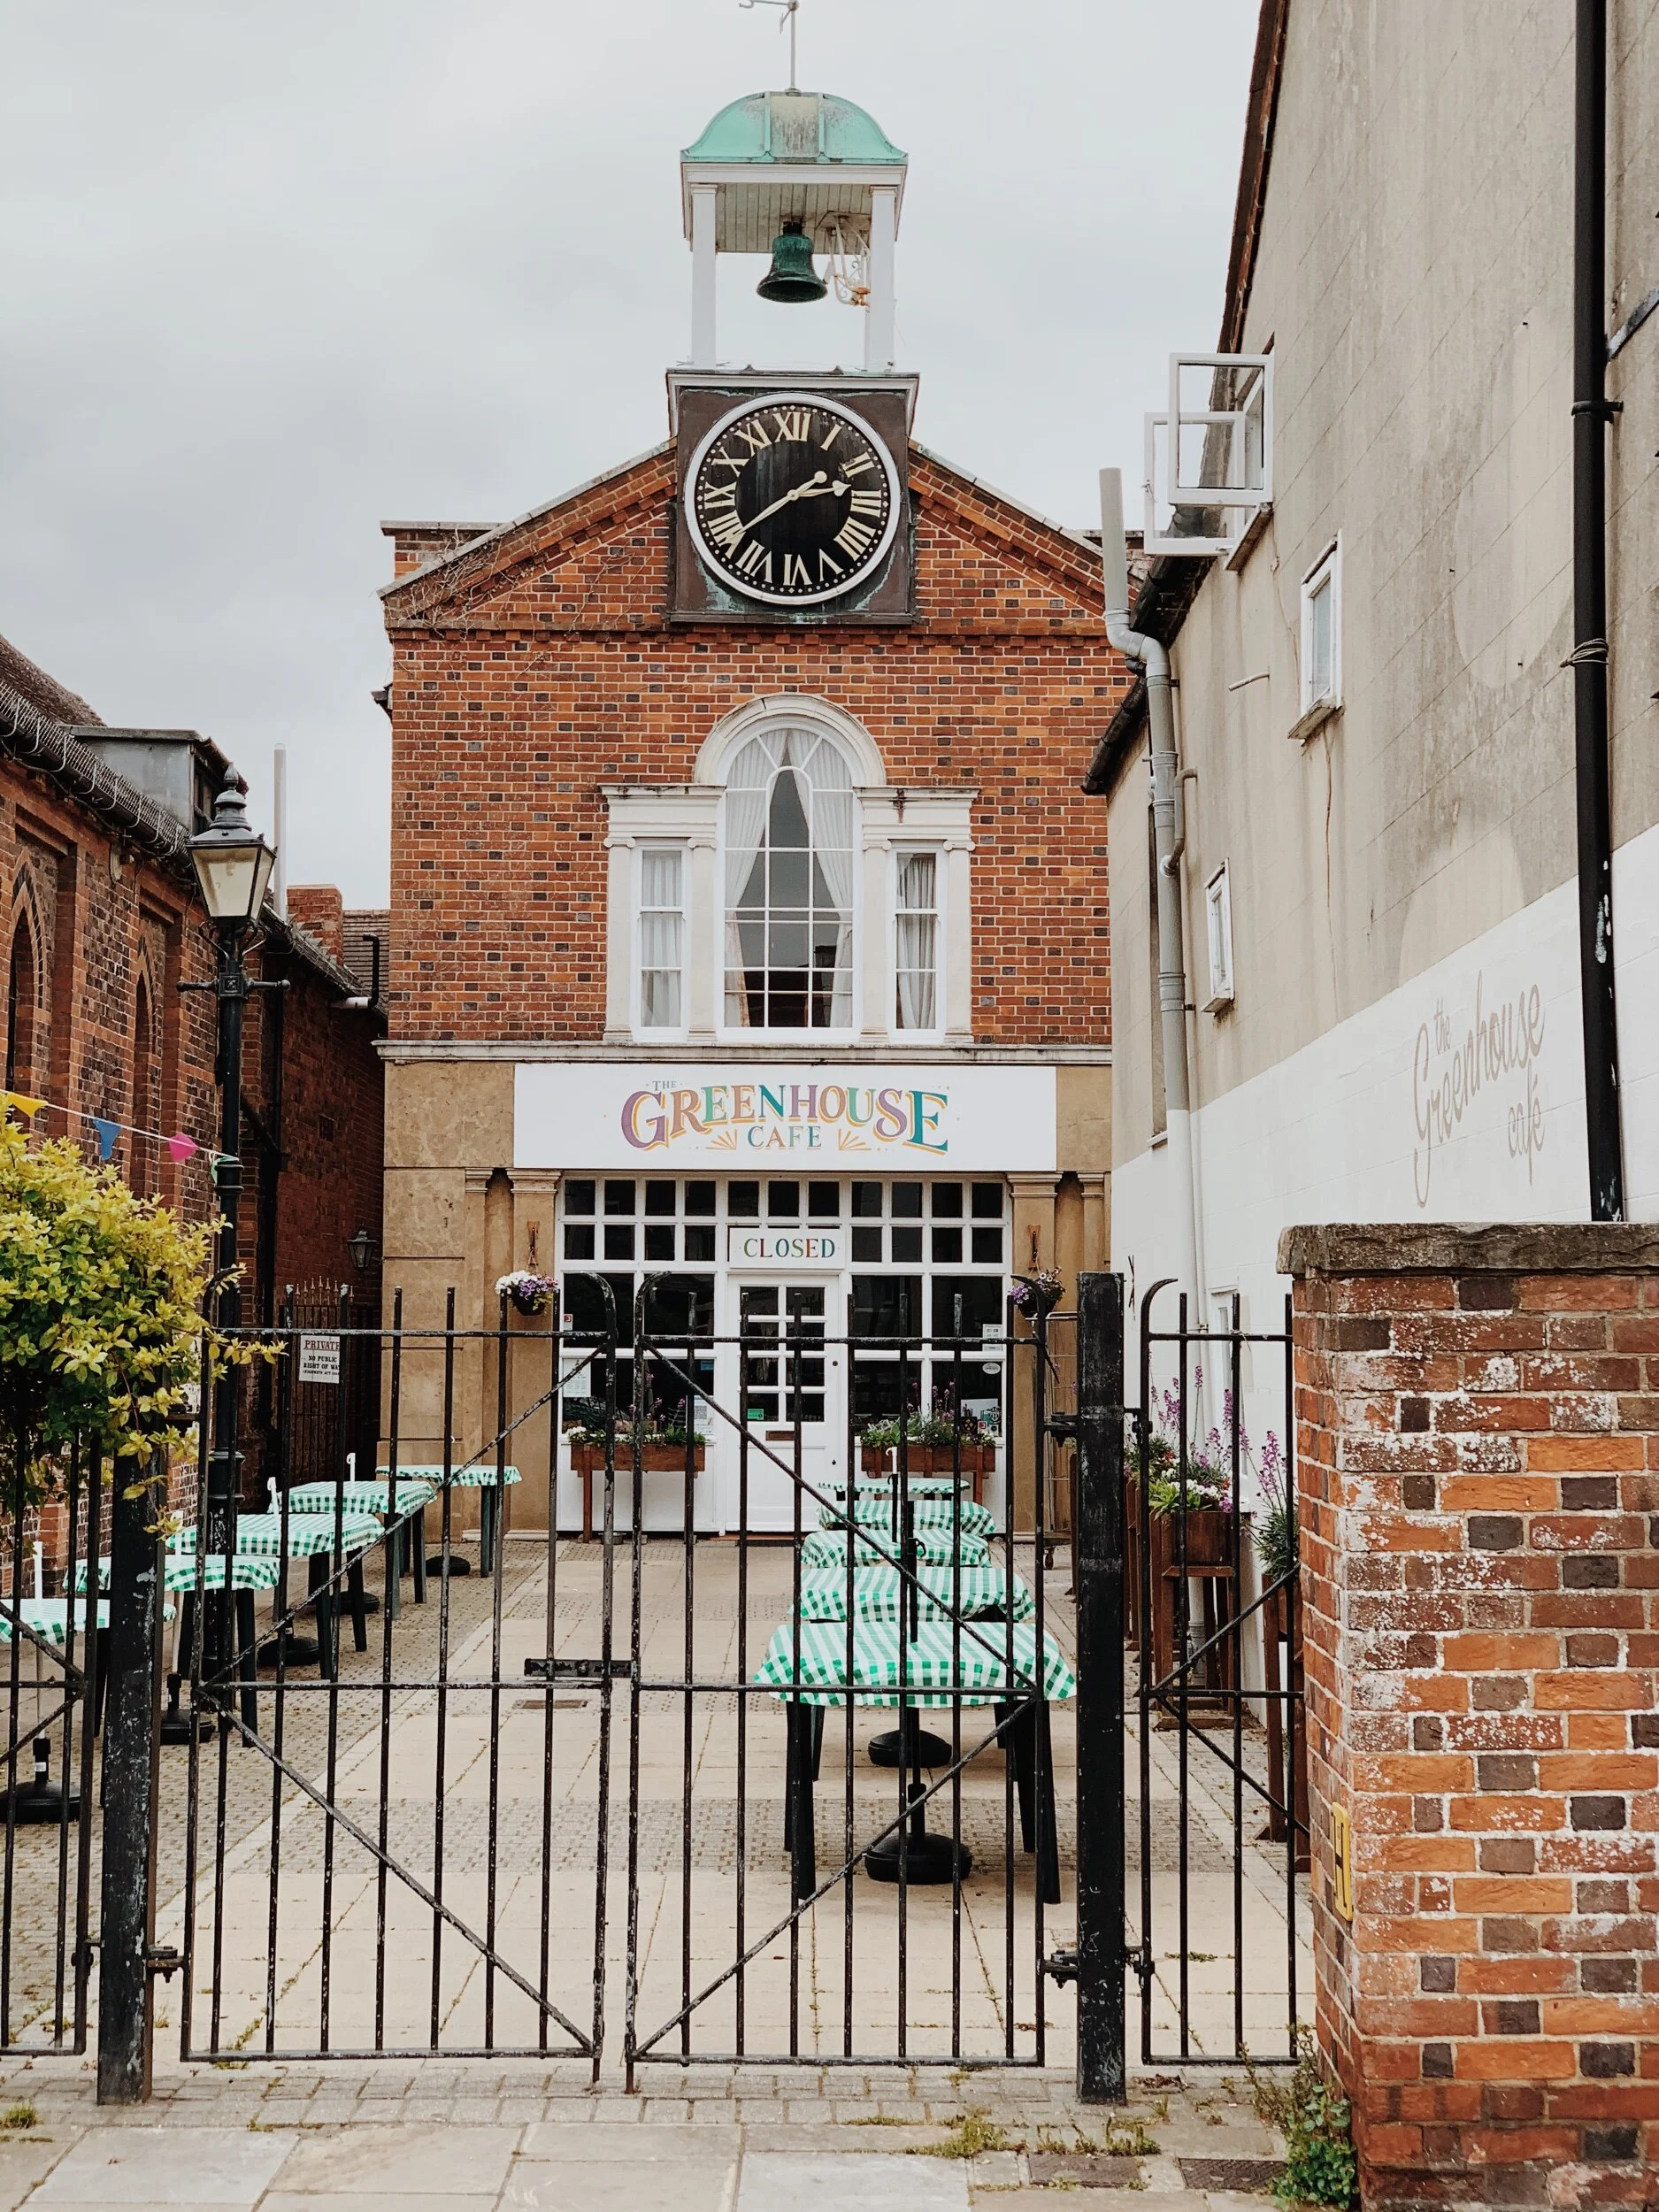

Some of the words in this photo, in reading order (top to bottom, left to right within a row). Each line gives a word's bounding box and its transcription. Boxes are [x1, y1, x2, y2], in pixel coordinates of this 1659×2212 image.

[733, 419, 773, 457] XI
[772, 411, 811, 442] XII
[819, 424, 842, 451] I
[710, 446, 750, 478] X
[841, 451, 875, 479] II
[703, 480, 737, 511] IX
[849, 489, 882, 518] III
[707, 510, 747, 559] VIII
[833, 516, 877, 562] IIII
[735, 540, 772, 584] VII
[782, 554, 812, 587] VI
[818, 548, 844, 582] V
[1433, 996, 1451, 1055] the
[651, 1080, 677, 1092] THE
[1413, 969, 1546, 1208] Greenhouse
[620, 1084, 949, 1154] GREENHOUSE
[747, 1125, 822, 1148] CAFE
[743, 1238, 835, 1258] CLOSED
[304, 1340, 340, 1349] PRIVATE
